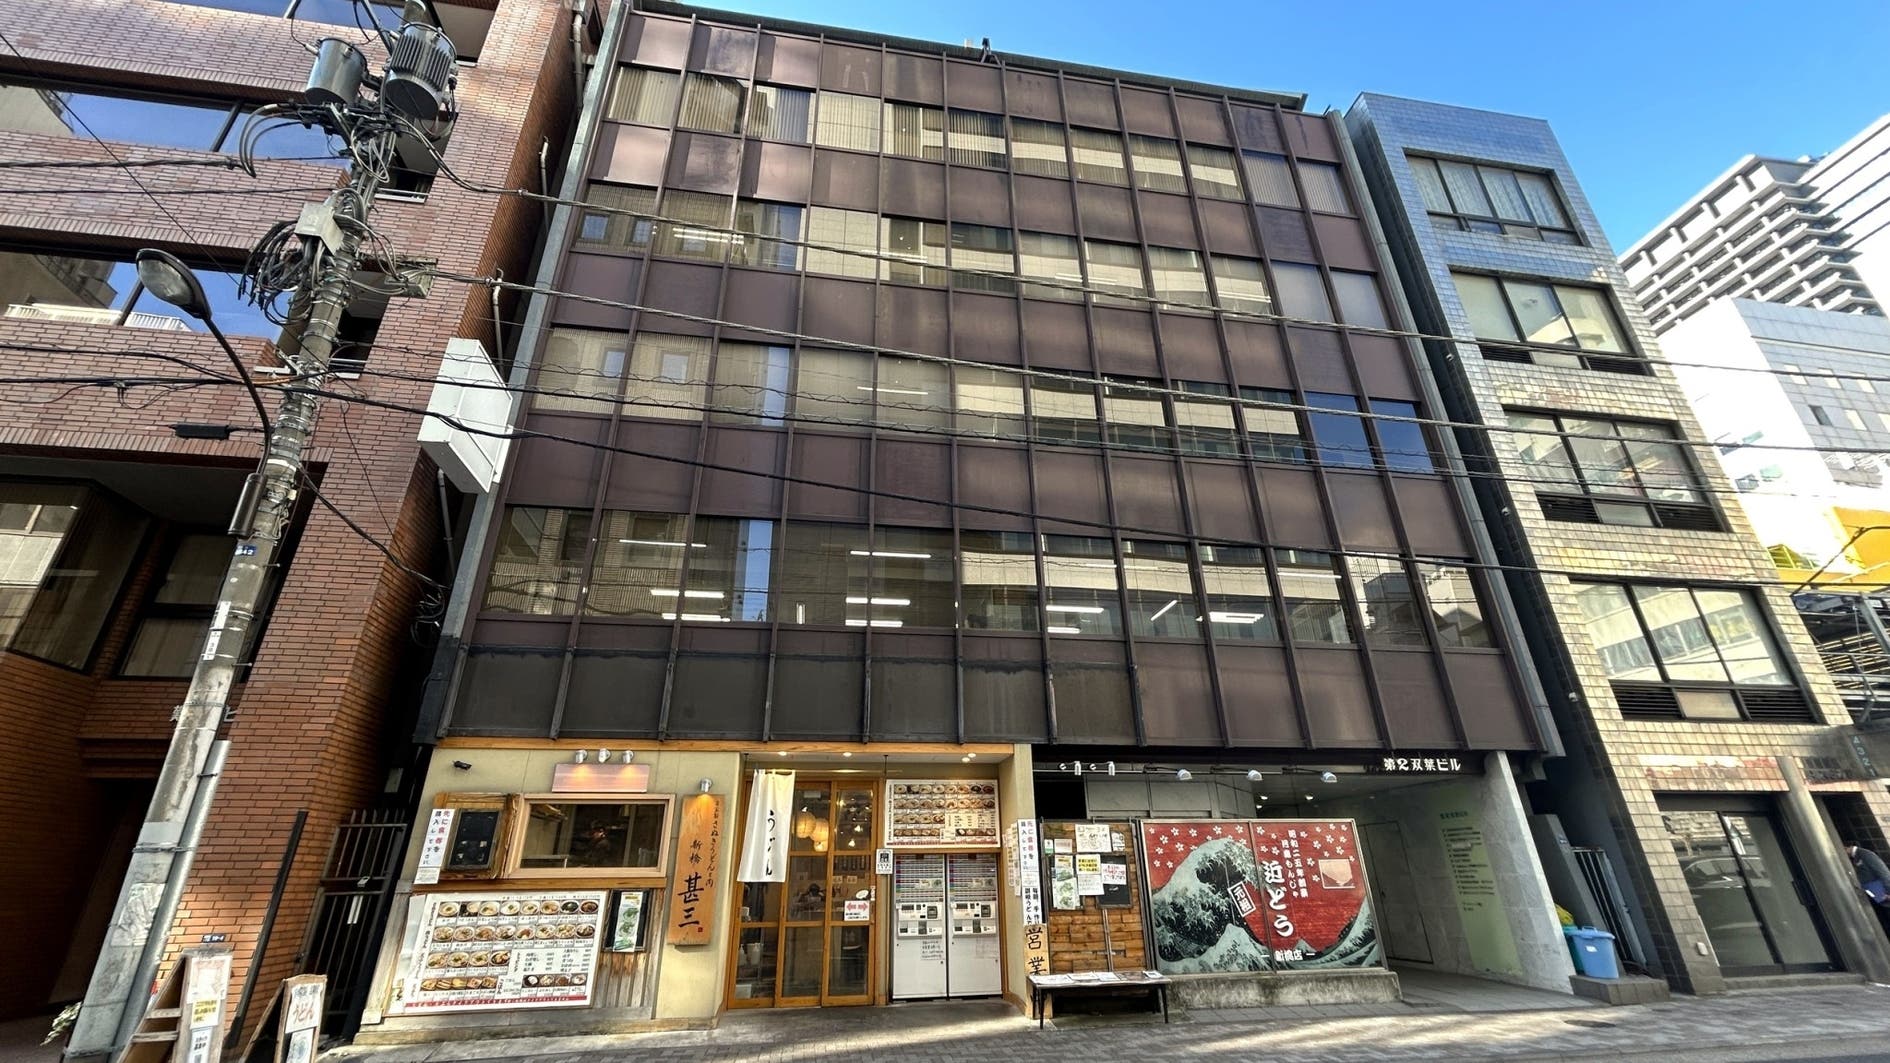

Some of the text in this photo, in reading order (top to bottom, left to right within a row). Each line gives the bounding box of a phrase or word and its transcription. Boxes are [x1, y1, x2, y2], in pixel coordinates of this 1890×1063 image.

[1383, 757, 1462, 772] 第2双葉ビル
[766, 810, 776, 876] うどん
[677, 840, 704, 928] 新橋 甚三
[1262, 861, 1294, 937] 近どう
